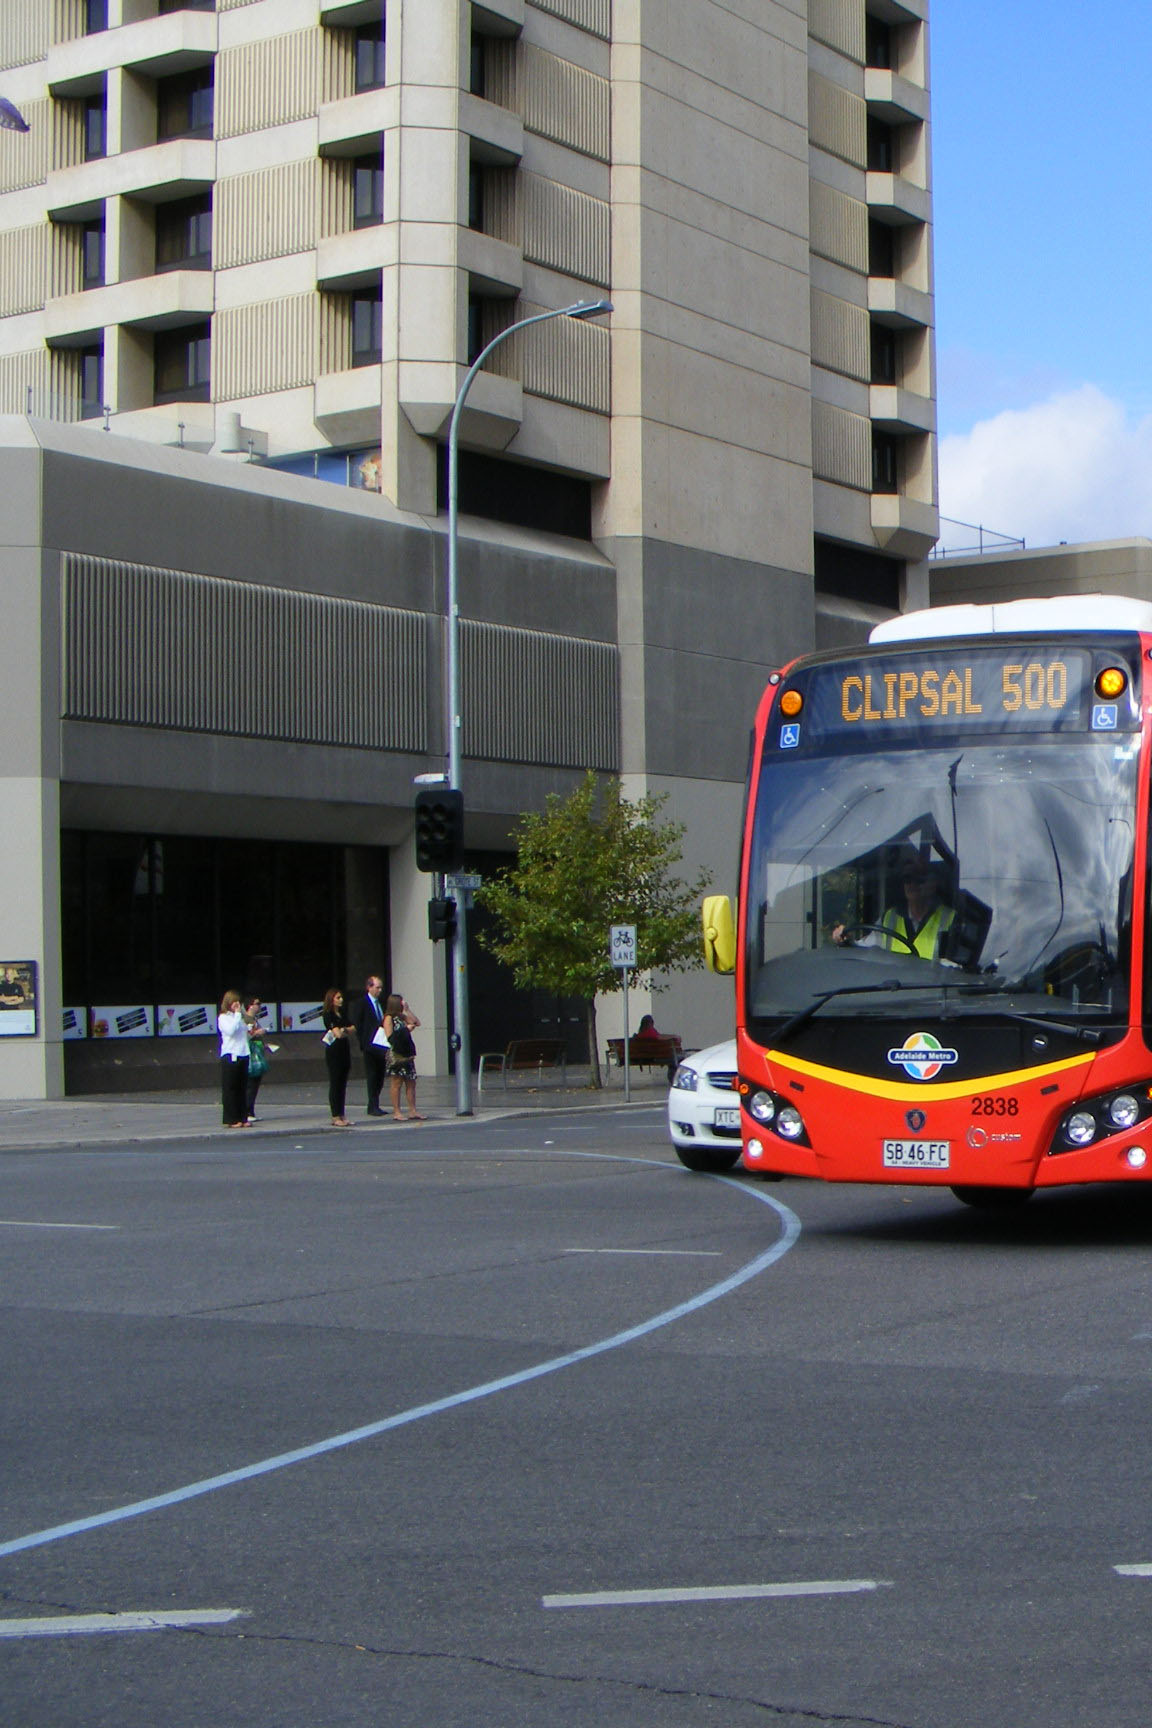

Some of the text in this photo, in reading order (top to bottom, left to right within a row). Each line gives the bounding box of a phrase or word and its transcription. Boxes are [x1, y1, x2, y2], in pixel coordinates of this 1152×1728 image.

[842, 662, 1067, 721] CLIPSAL 500
[614, 951, 634, 960] LANE
[895, 1052, 951, 1061] Adelaide Metro
[971, 1097, 1019, 1116] 2838
